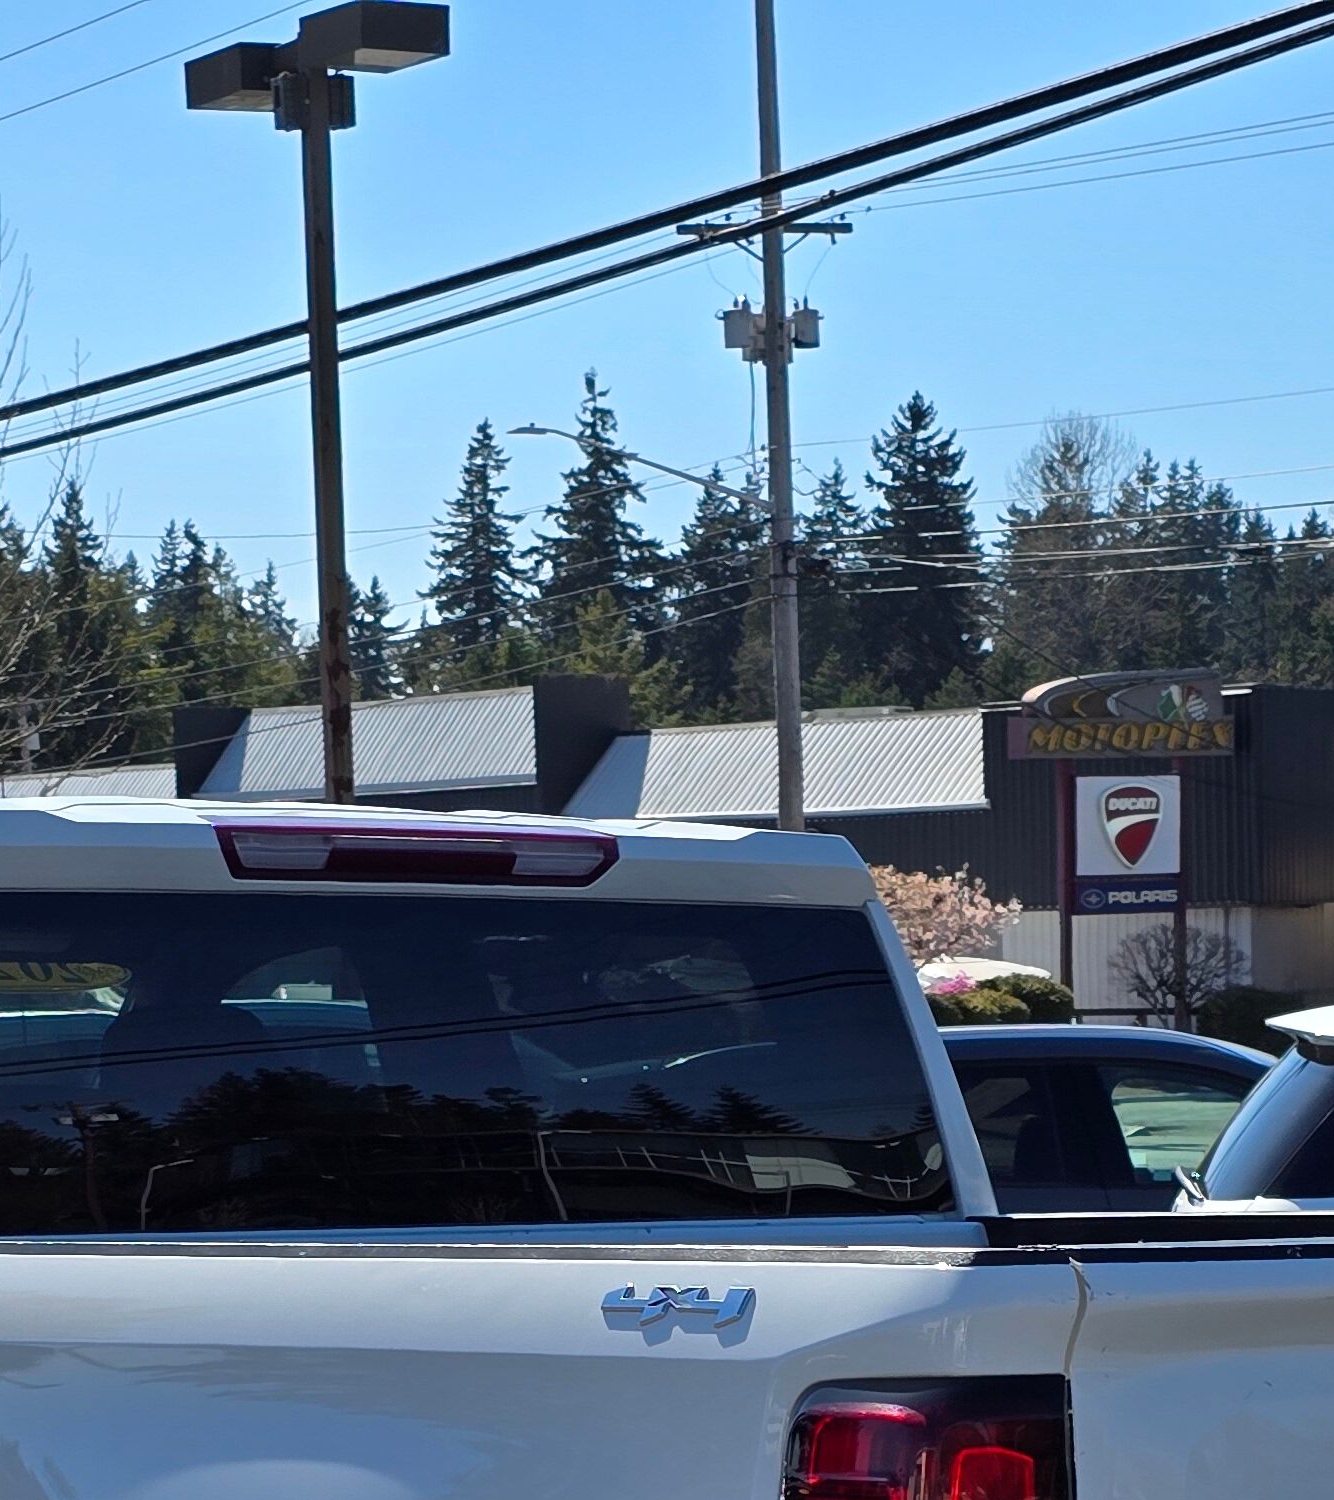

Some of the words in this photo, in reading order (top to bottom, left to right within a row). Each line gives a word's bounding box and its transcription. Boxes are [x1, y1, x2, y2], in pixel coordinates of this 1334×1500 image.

[1029, 720, 1233, 752] MOTOPLEX
[1108, 797, 1157, 811] DUCATI
[1108, 889, 1178, 904] POLARIS
